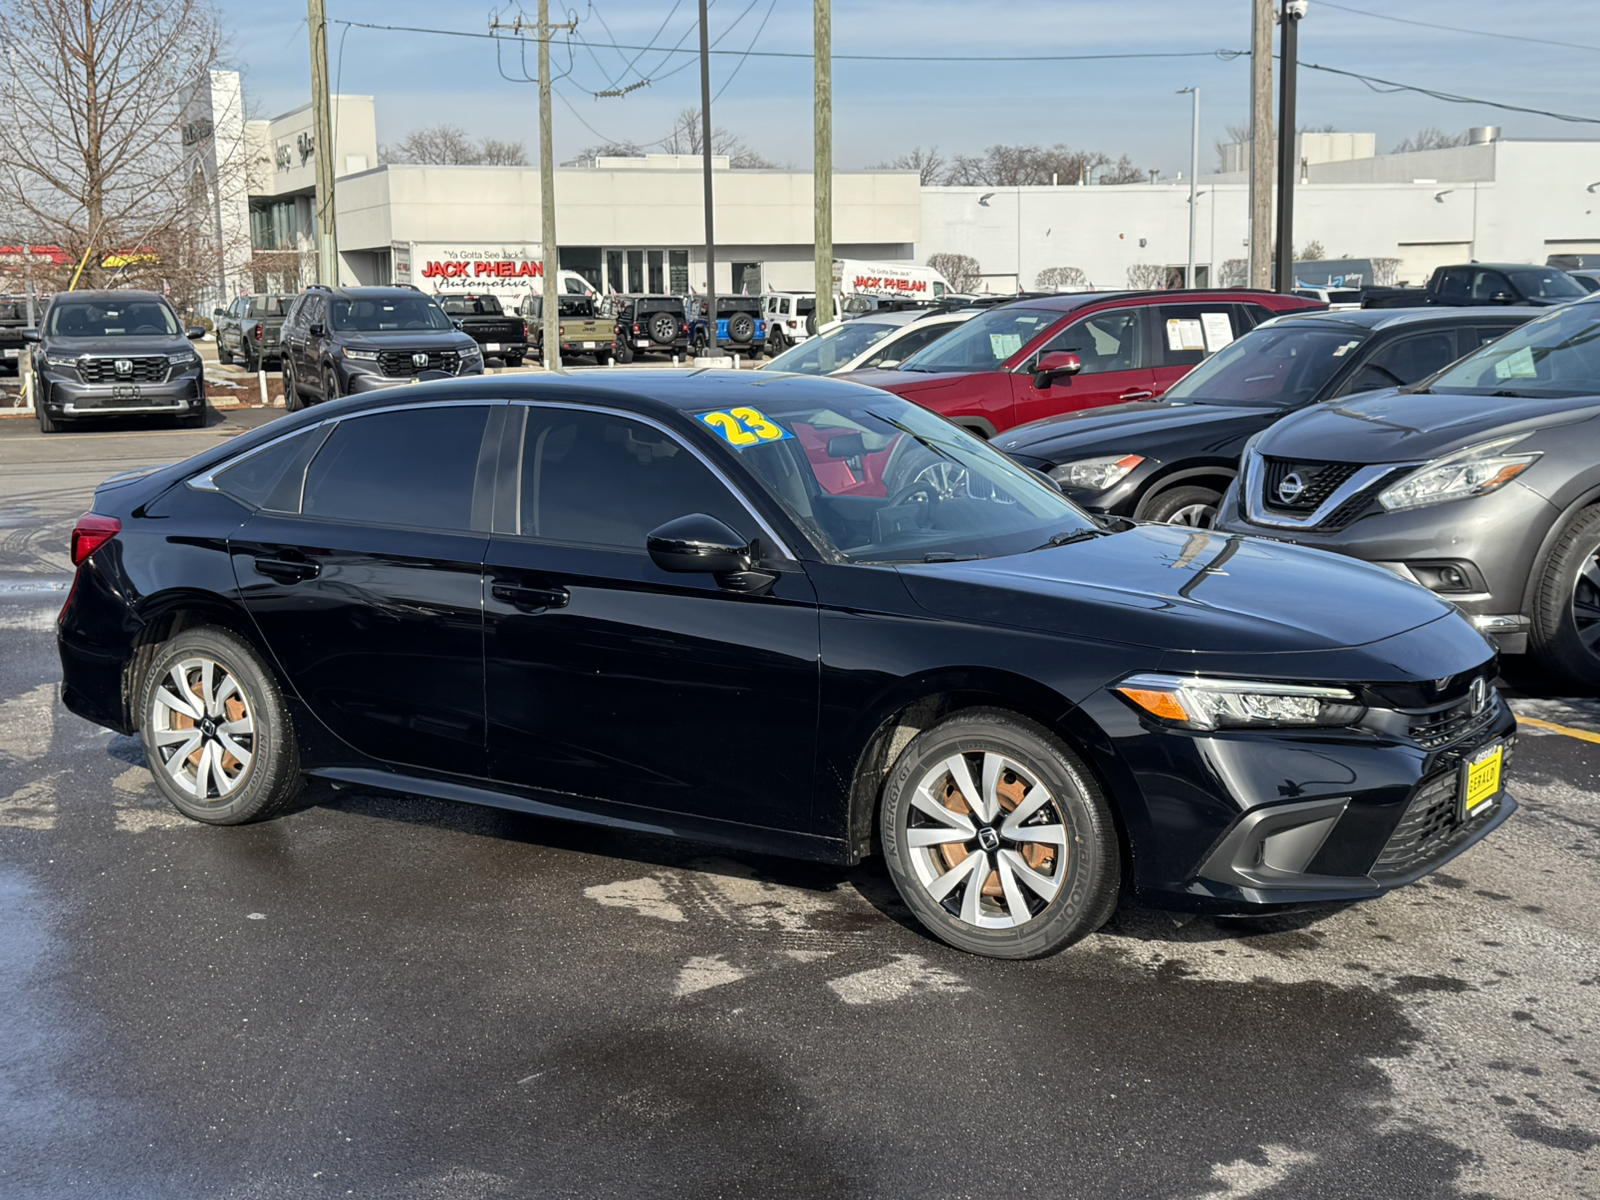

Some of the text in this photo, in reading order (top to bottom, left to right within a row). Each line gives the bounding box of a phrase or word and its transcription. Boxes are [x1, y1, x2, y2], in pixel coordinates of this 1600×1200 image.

[460, 250, 482, 259] Gotta
[484, 250, 500, 259] See
[421, 261, 471, 278] JACK
[474, 261, 544, 278] PHELAN
[439, 277, 529, 289] Automotive
[855, 276, 927, 293] JACK PHELAN
[704, 407, 783, 446] 23
